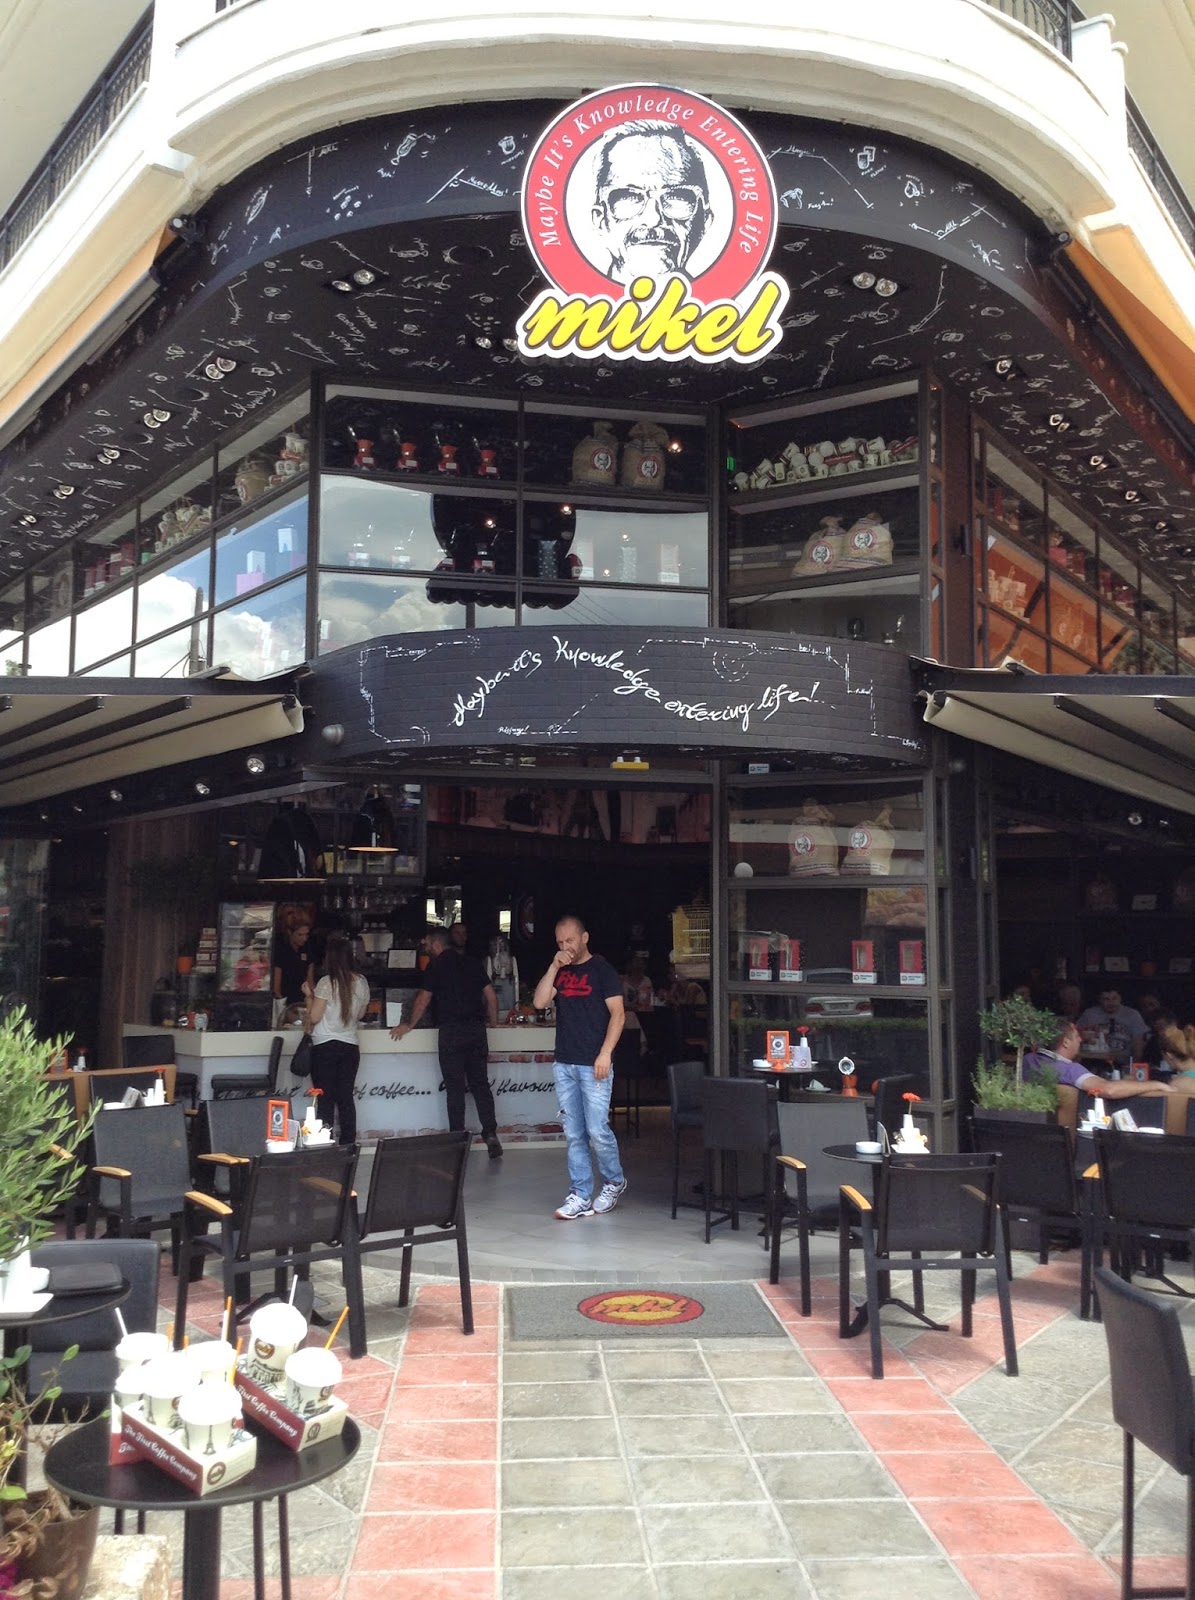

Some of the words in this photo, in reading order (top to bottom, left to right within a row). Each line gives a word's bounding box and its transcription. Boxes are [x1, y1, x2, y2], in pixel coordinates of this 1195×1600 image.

[573, 95, 695, 135] Knowledge
[543, 139, 574, 170] It's
[699, 115, 760, 202] Entering
[534, 174, 562, 248] Maybe
[739, 210, 764, 254] Life
[524, 276, 782, 355] mikel
[552, 635, 661, 703] Knowledge
[663, 699, 755, 732] entering
[757, 681, 821, 721] life!
[269, 1410, 299, 1437] Company
[151, 1441, 170, 1461] Coffee
[168, 1455, 198, 1481] Company
